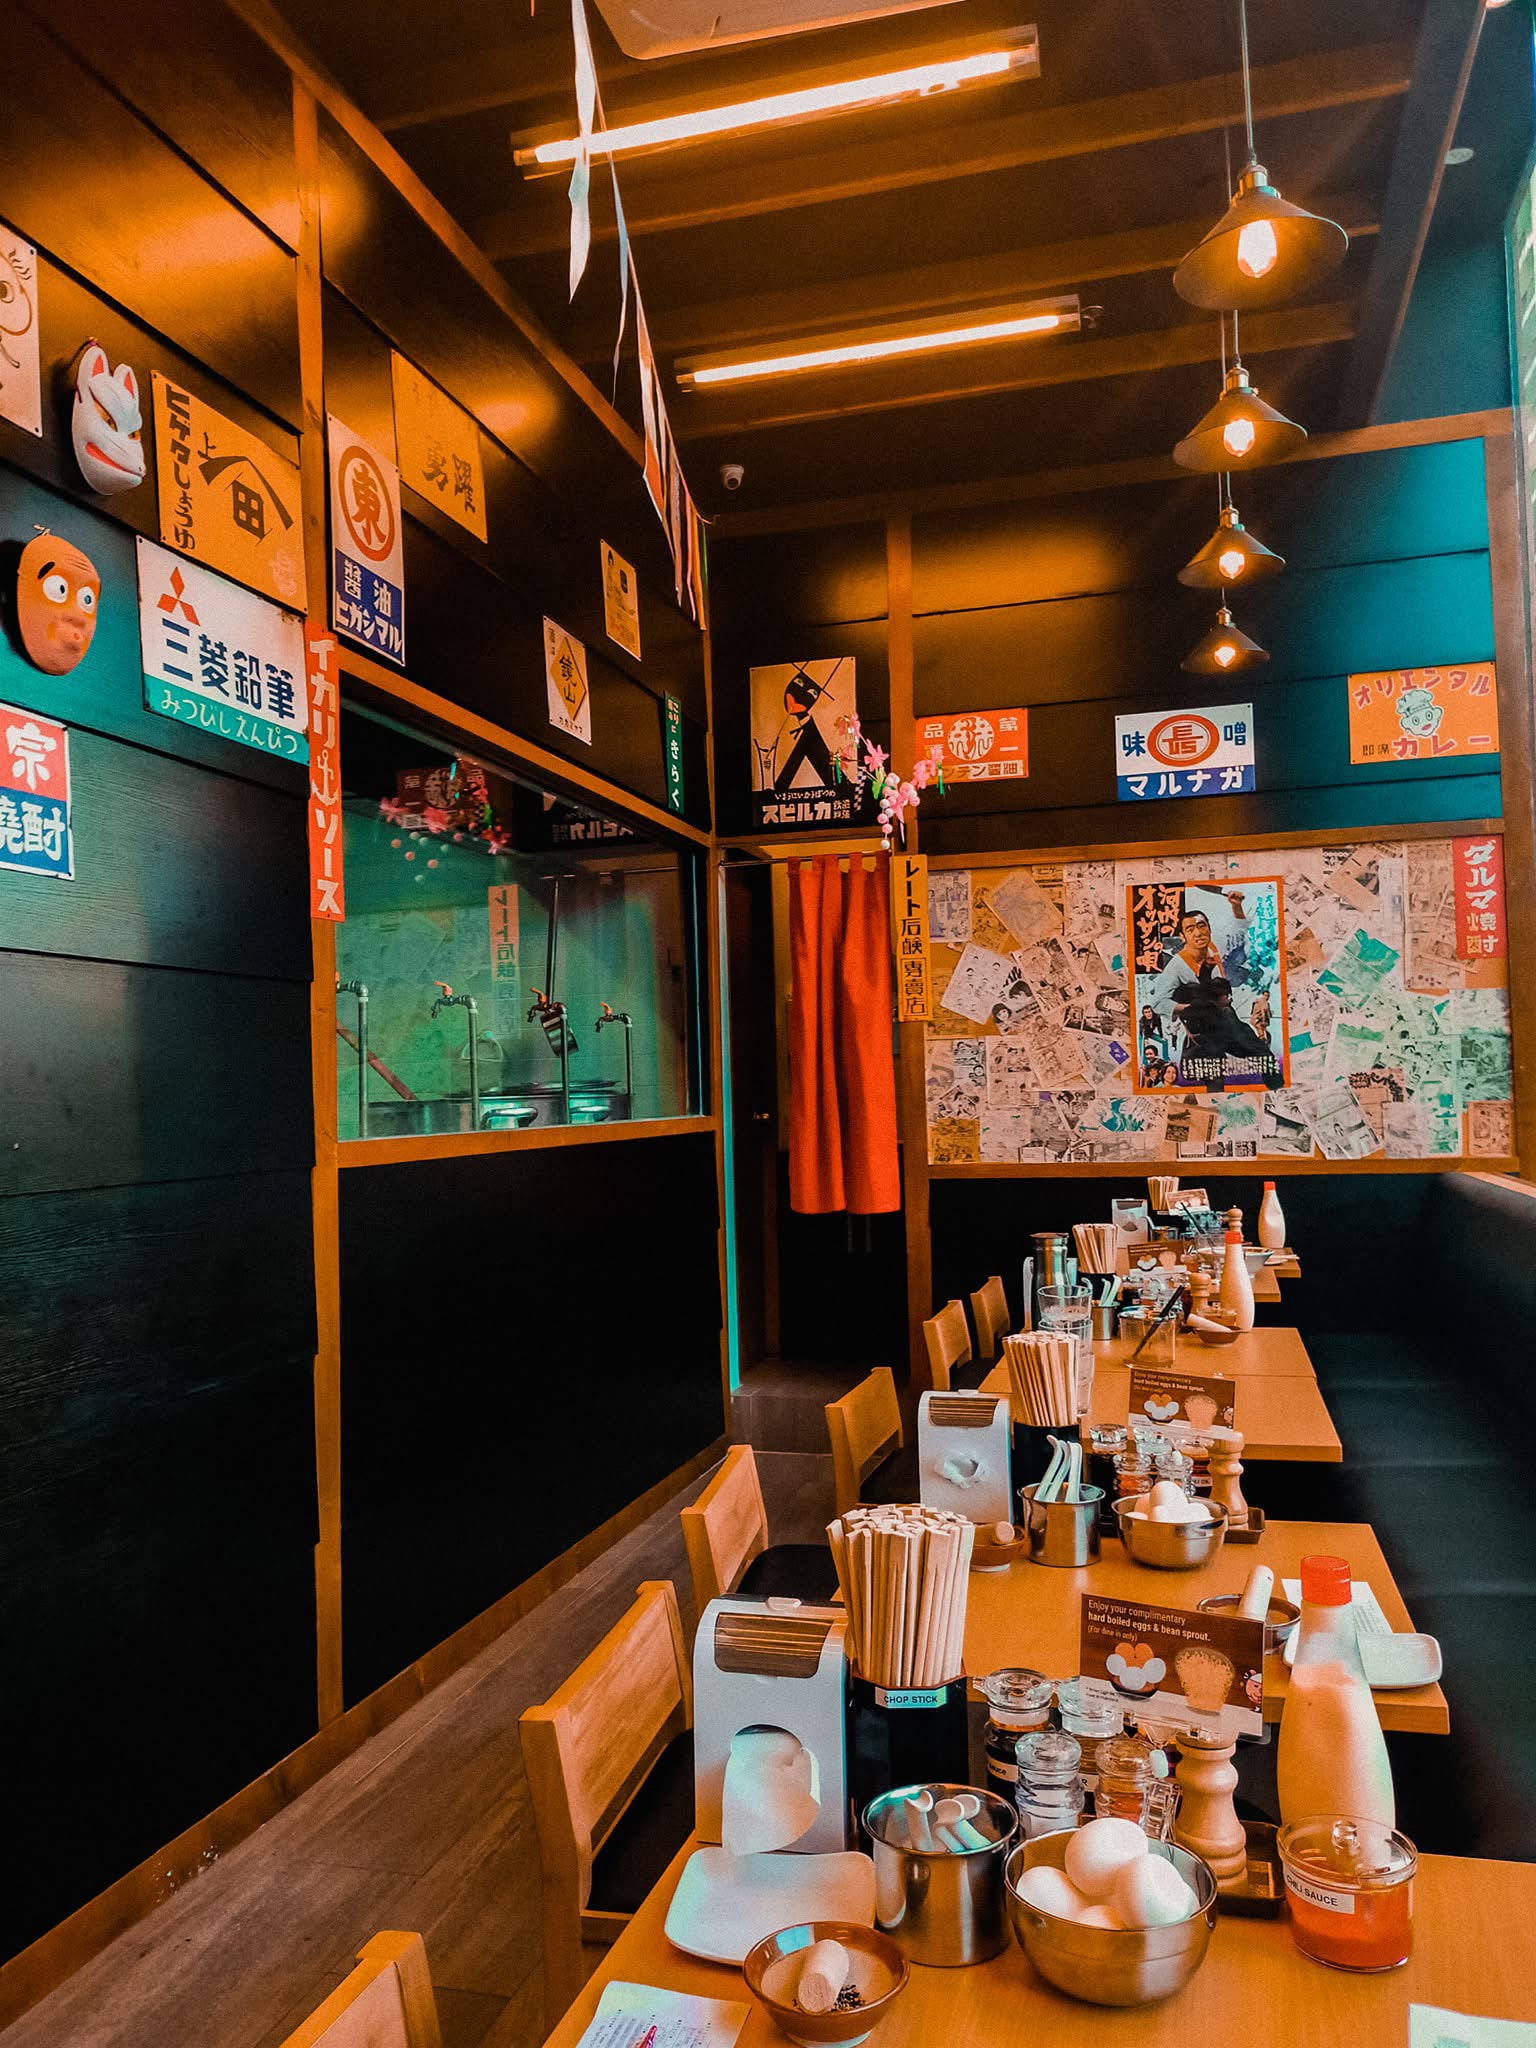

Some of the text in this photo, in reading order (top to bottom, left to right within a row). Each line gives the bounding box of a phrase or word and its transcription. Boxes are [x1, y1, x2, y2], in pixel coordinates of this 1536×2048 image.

[336, 592, 403, 654] ヒガシマル
[162, 618, 296, 720] 三菱鉛筆
[1353, 669, 1491, 708] オリエンタル
[160, 689, 298, 754] みつびしえんぴつ
[1392, 735, 1491, 758] カレー
[1126, 766, 1245, 797] マルナガ
[1088, 1600, 1186, 1626] Enjoy your complimentary
[1088, 1611, 1105, 1622] hard
[1107, 1615, 1131, 1627] boiled
[1132, 1621, 1152, 1632] eggs
[1153, 1623, 1159, 1632] &
[1161, 1625, 1181, 1636] bean
[884, 1695, 938, 1704] CHOP STICK
[1304, 1888, 1338, 1906] SAUCE
